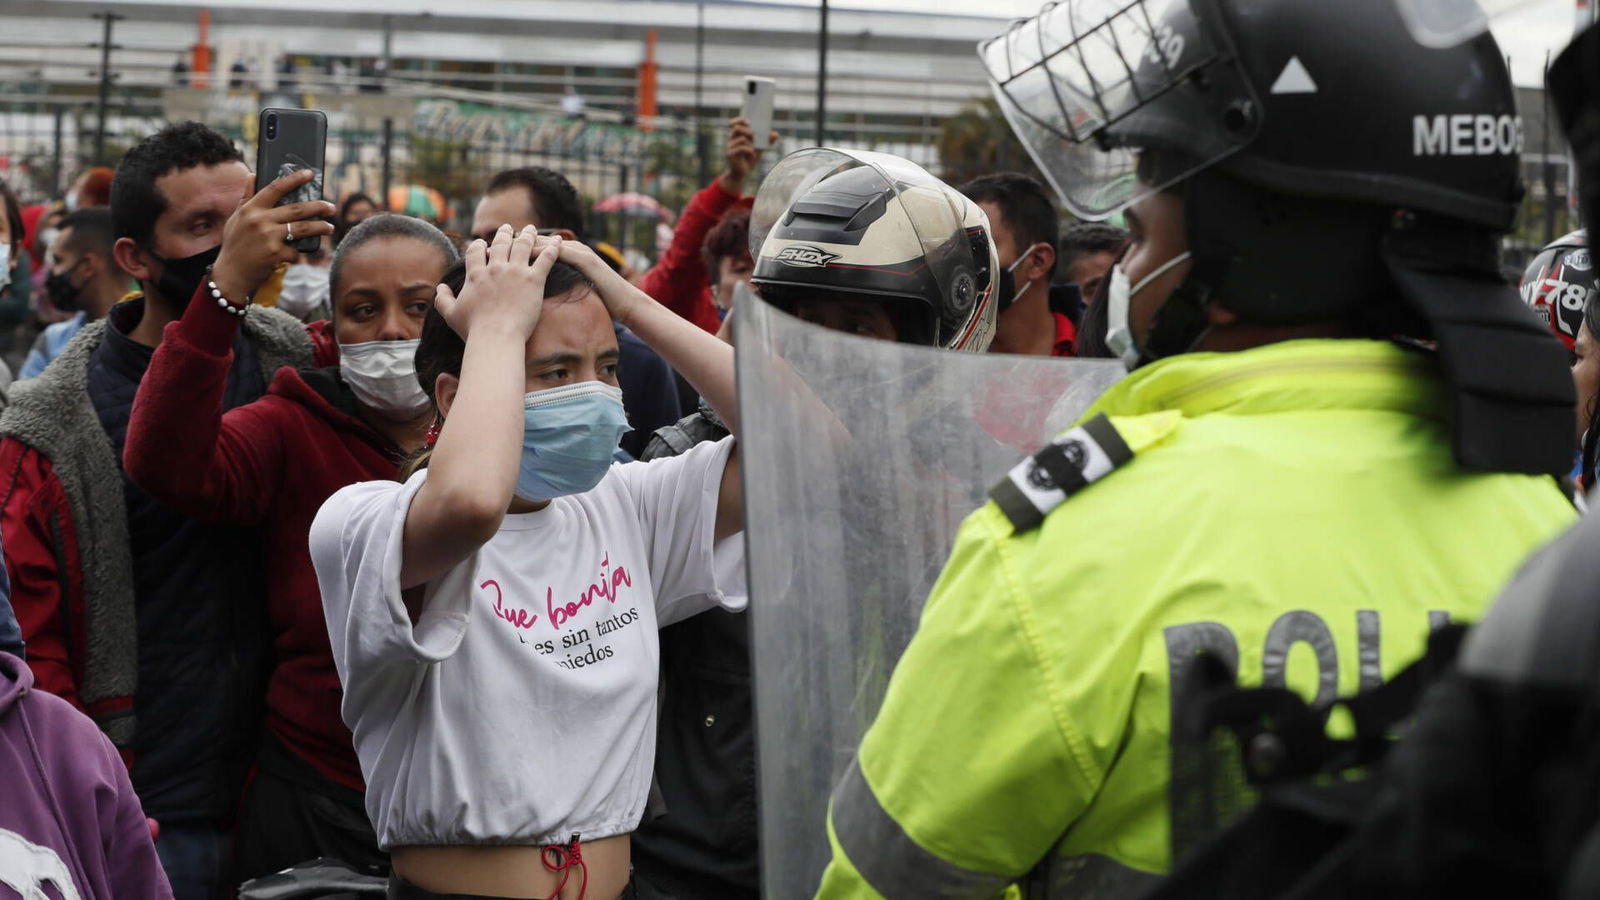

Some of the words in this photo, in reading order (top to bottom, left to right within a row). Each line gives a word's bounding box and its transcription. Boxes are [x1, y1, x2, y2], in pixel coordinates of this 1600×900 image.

[546, 550, 632, 631] bonita
[561, 629, 591, 650] sin
[595, 607, 639, 636] tantos
